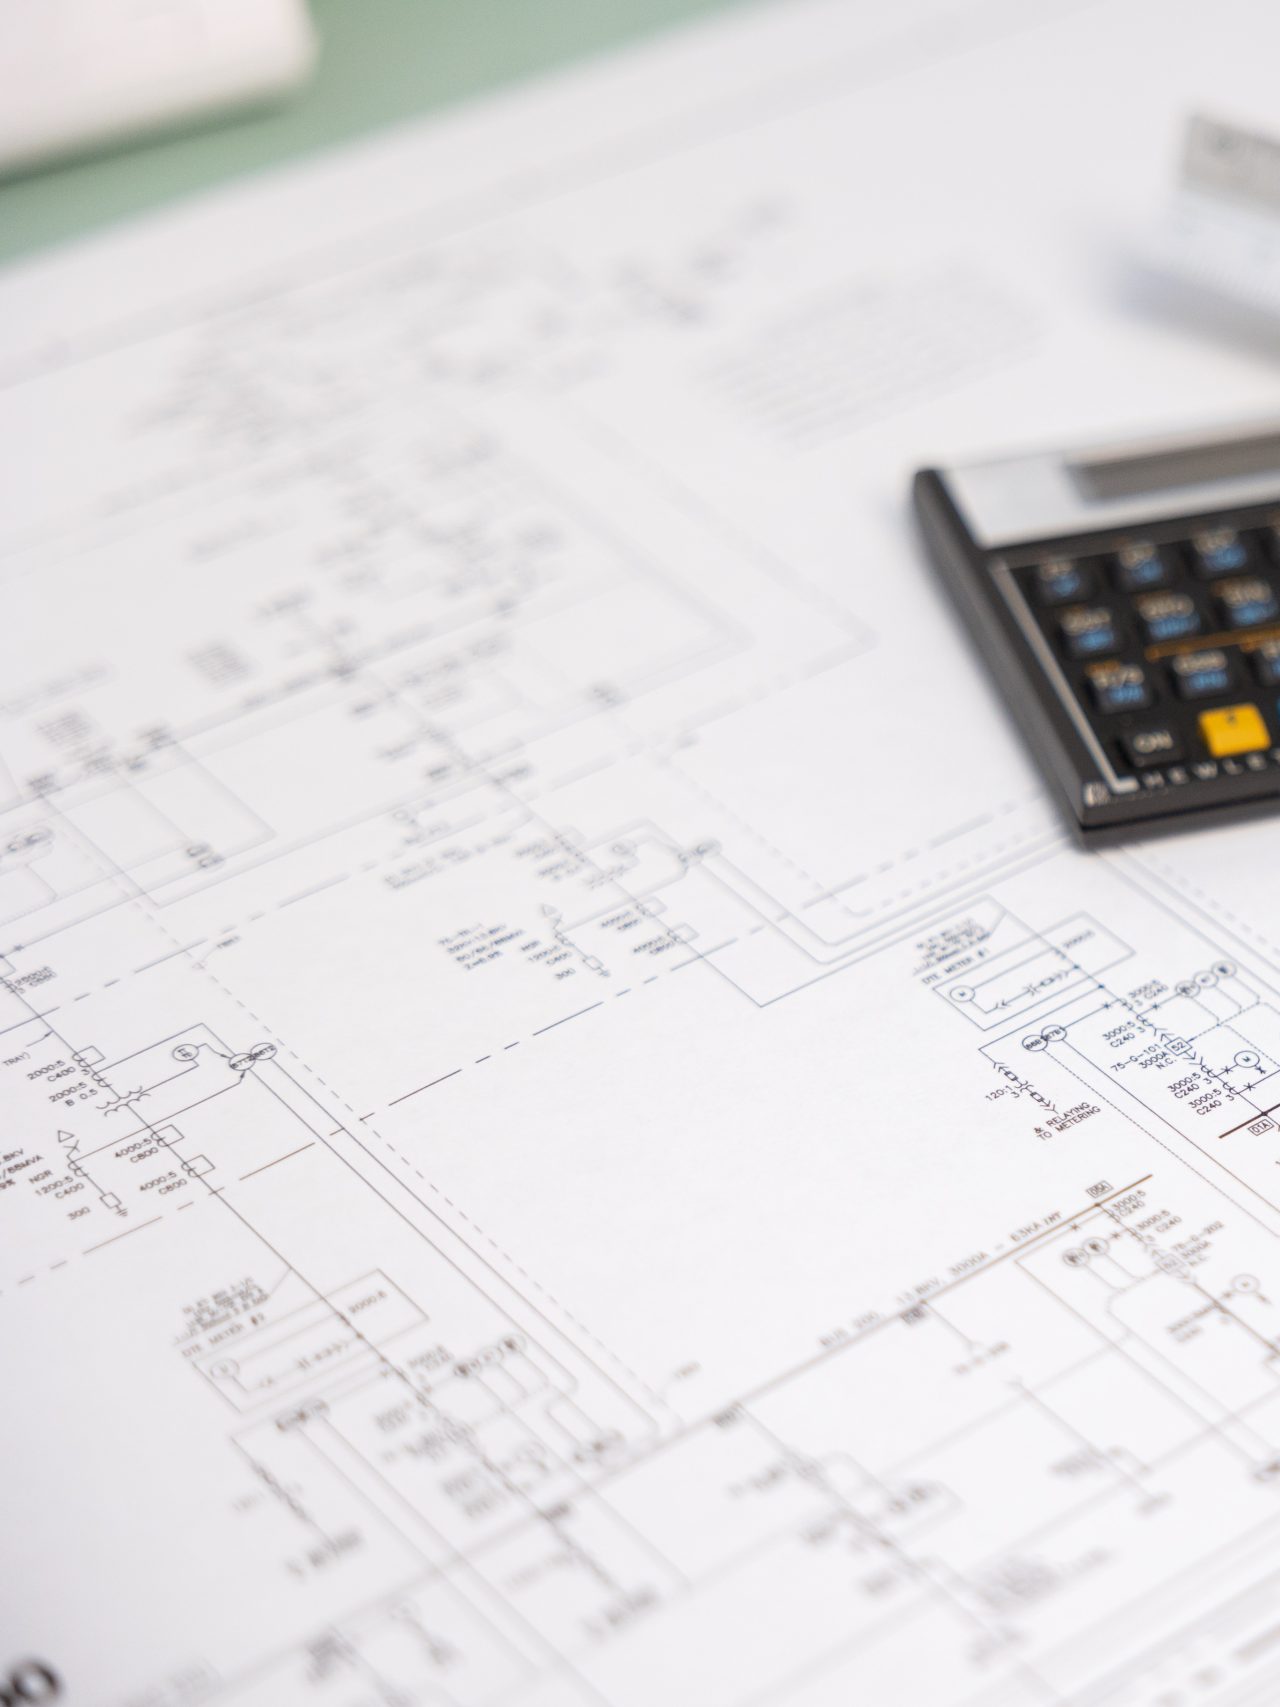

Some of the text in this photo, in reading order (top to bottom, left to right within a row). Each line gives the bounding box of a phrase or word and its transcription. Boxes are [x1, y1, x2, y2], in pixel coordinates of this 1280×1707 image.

[1102, 1021, 1136, 1041] 3000:5
[1110, 1032, 1136, 1048] C240
[1171, 1041, 1185, 1052] 52
[1138, 1050, 1168, 1069] 3000A
[1167, 1072, 1201, 1093] 3000:5
[1174, 1083, 1200, 1099] C240
[985, 1085, 1012, 1101] 120:1
[1188, 1089, 1222, 1109] 3000:5
[1046, 1102, 1090, 1127] RELAYING
[1195, 1100, 1222, 1116] C240
[1037, 1105, 1101, 1141] TO METERING
[1252, 1121, 1270, 1134] 01A
